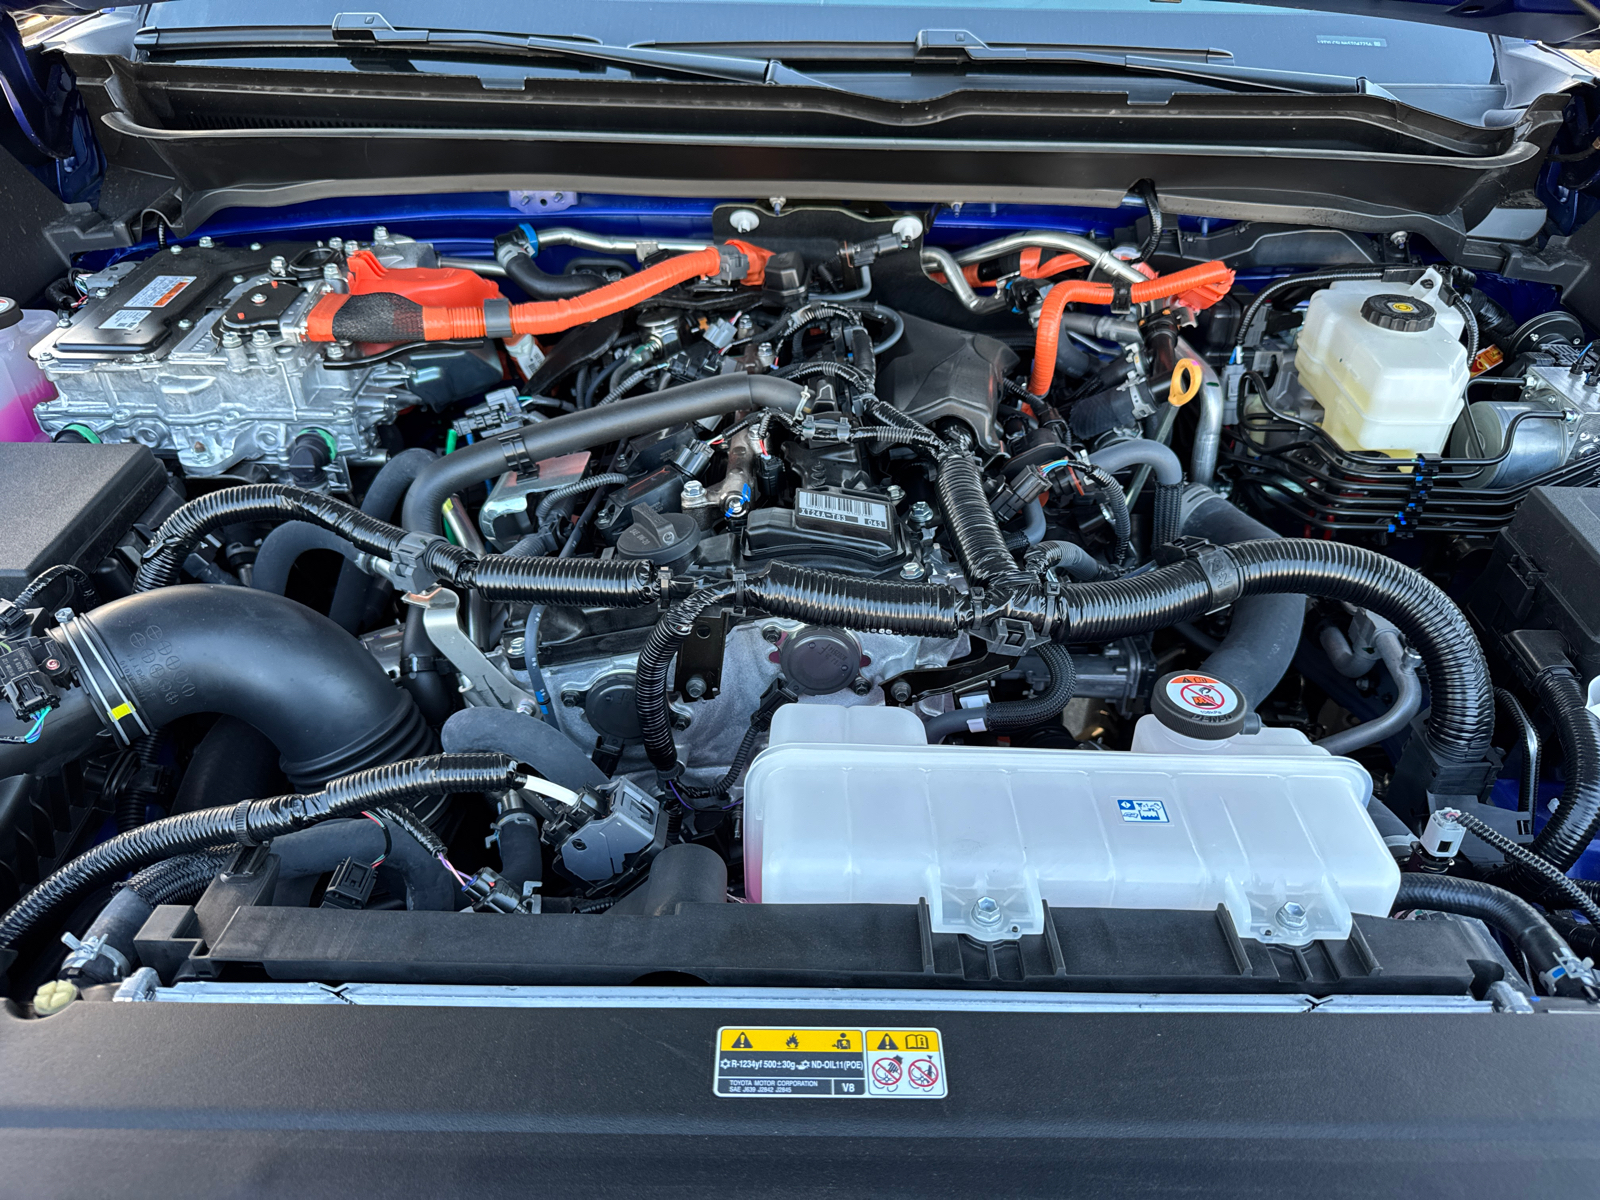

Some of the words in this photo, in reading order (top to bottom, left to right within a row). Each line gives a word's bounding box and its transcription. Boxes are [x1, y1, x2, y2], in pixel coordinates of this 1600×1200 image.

[1191, 713, 1234, 723] DENSO
[731, 1059, 763, 1070] R-1234yf
[763, 1060, 796, 1071] 500±30g
[811, 1060, 864, 1071] ND-OIL11(POE)
[729, 1079, 753, 1087] TOYOTA
[754, 1079, 776, 1087] MOTOR
[841, 1082, 855, 1093] V8
